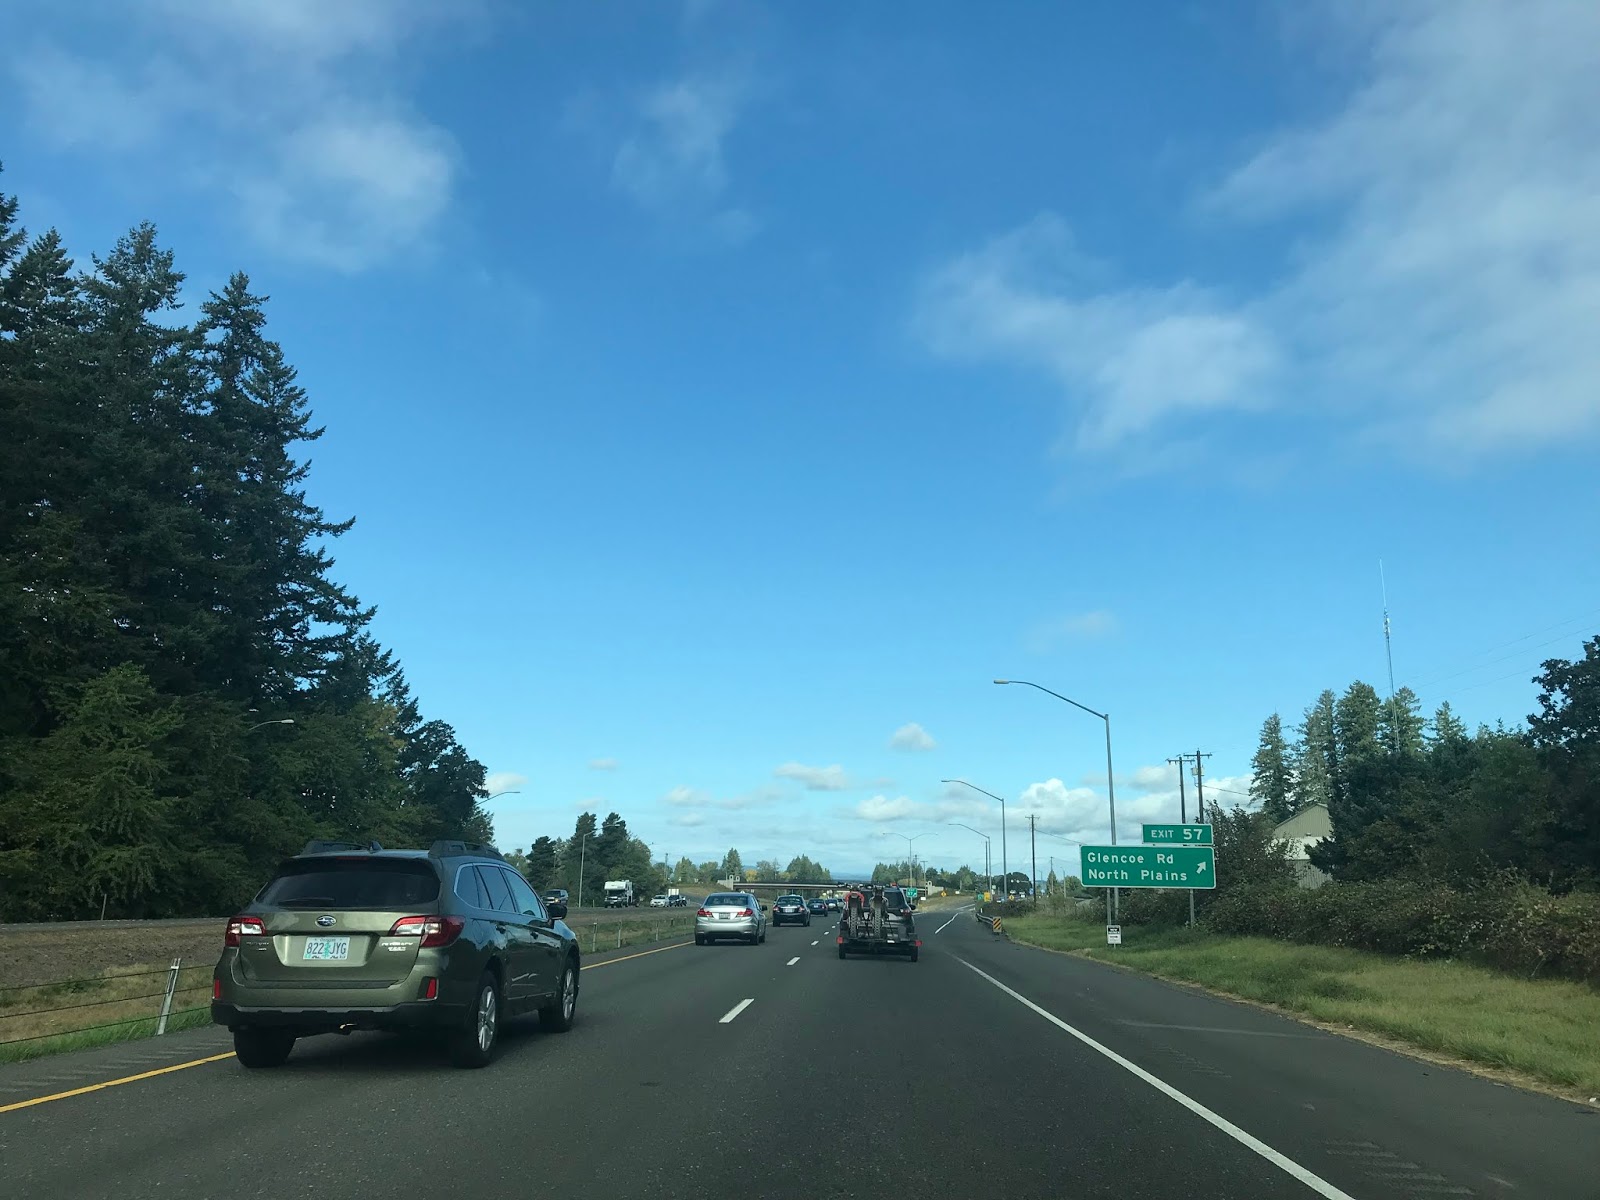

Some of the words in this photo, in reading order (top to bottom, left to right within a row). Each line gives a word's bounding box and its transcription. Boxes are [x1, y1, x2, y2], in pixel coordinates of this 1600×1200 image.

[1151, 829, 1174, 838] EXIT
[1183, 828, 1203, 840] 57
[1087, 852, 1144, 863] Glencoe
[1156, 853, 1174, 864] Rd
[1088, 868, 1128, 880] North
[1141, 869, 1187, 881] Plains
[306, 942, 324, 954] 822
[329, 942, 347, 954] JYG
